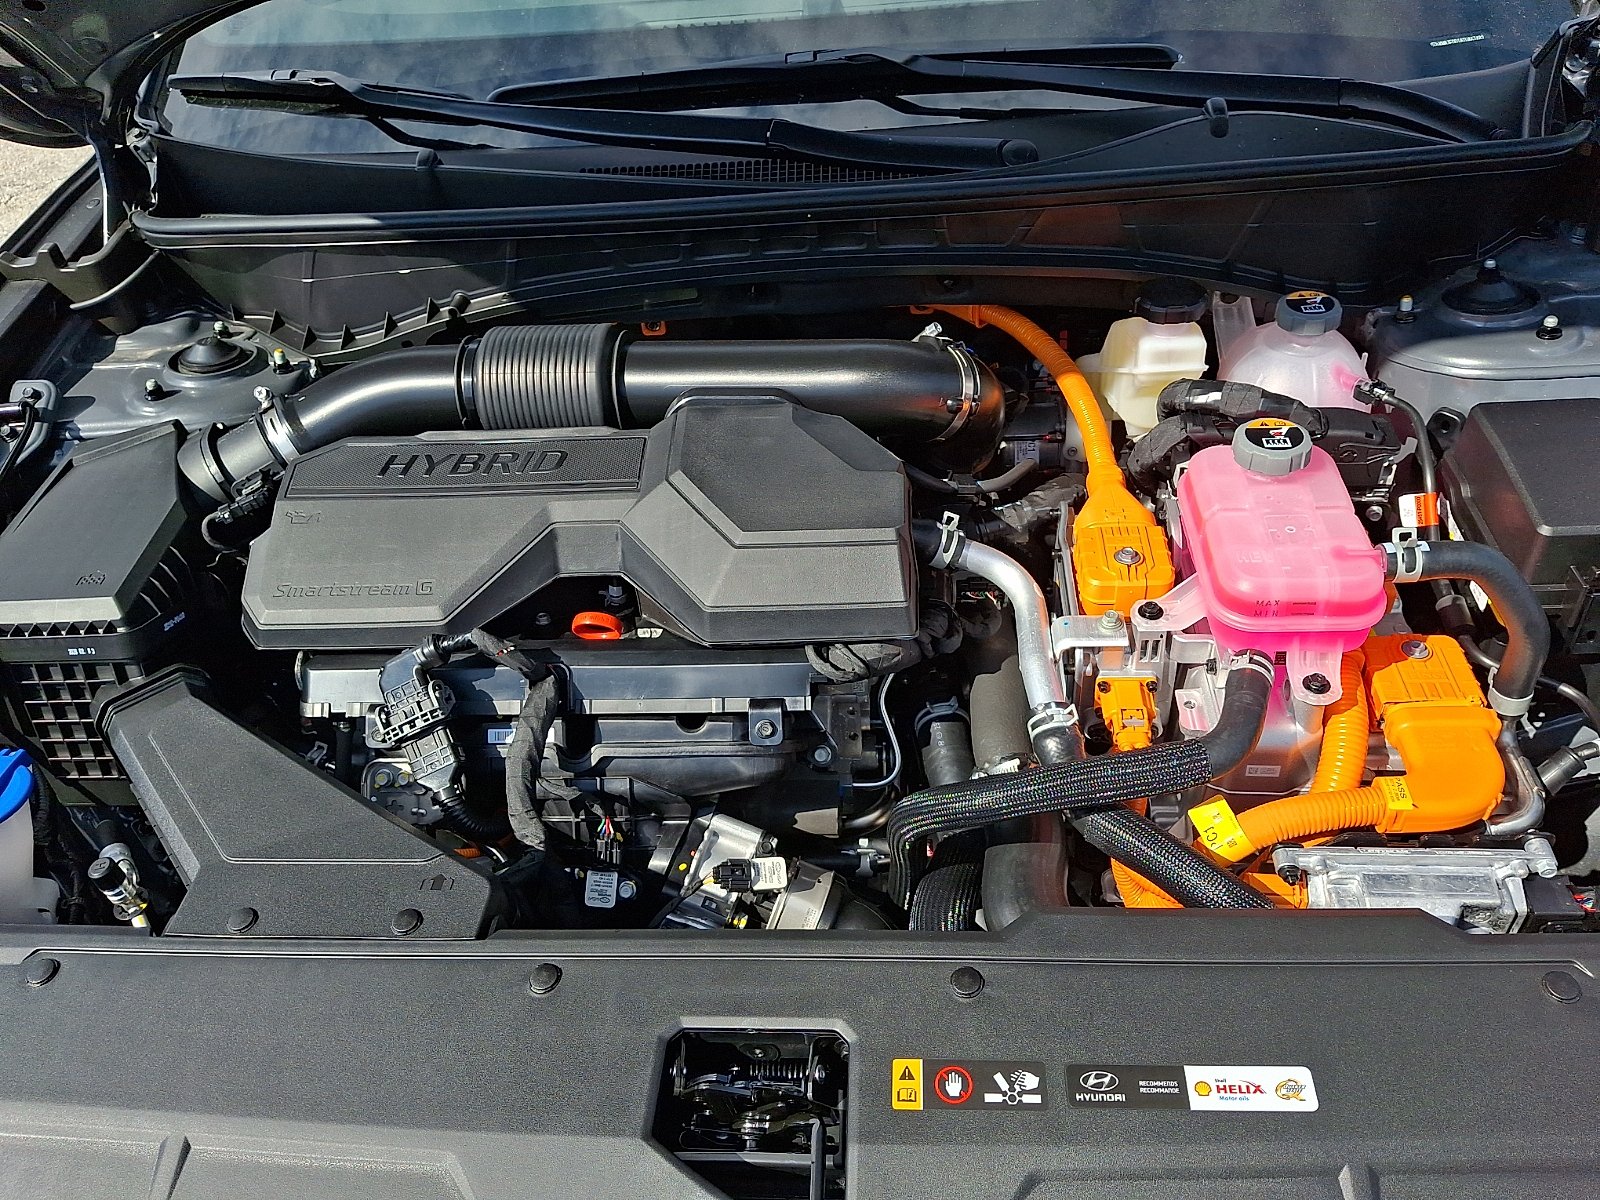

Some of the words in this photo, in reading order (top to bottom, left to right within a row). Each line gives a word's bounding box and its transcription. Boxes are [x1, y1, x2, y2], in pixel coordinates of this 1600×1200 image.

[377, 450, 568, 478] HYBRID
[272, 582, 413, 598] Smartstream
[1395, 777, 1408, 799] PASS
[1216, 1084, 1265, 1094] HELIX
[1075, 1093, 1126, 1102] HYUNDAI
